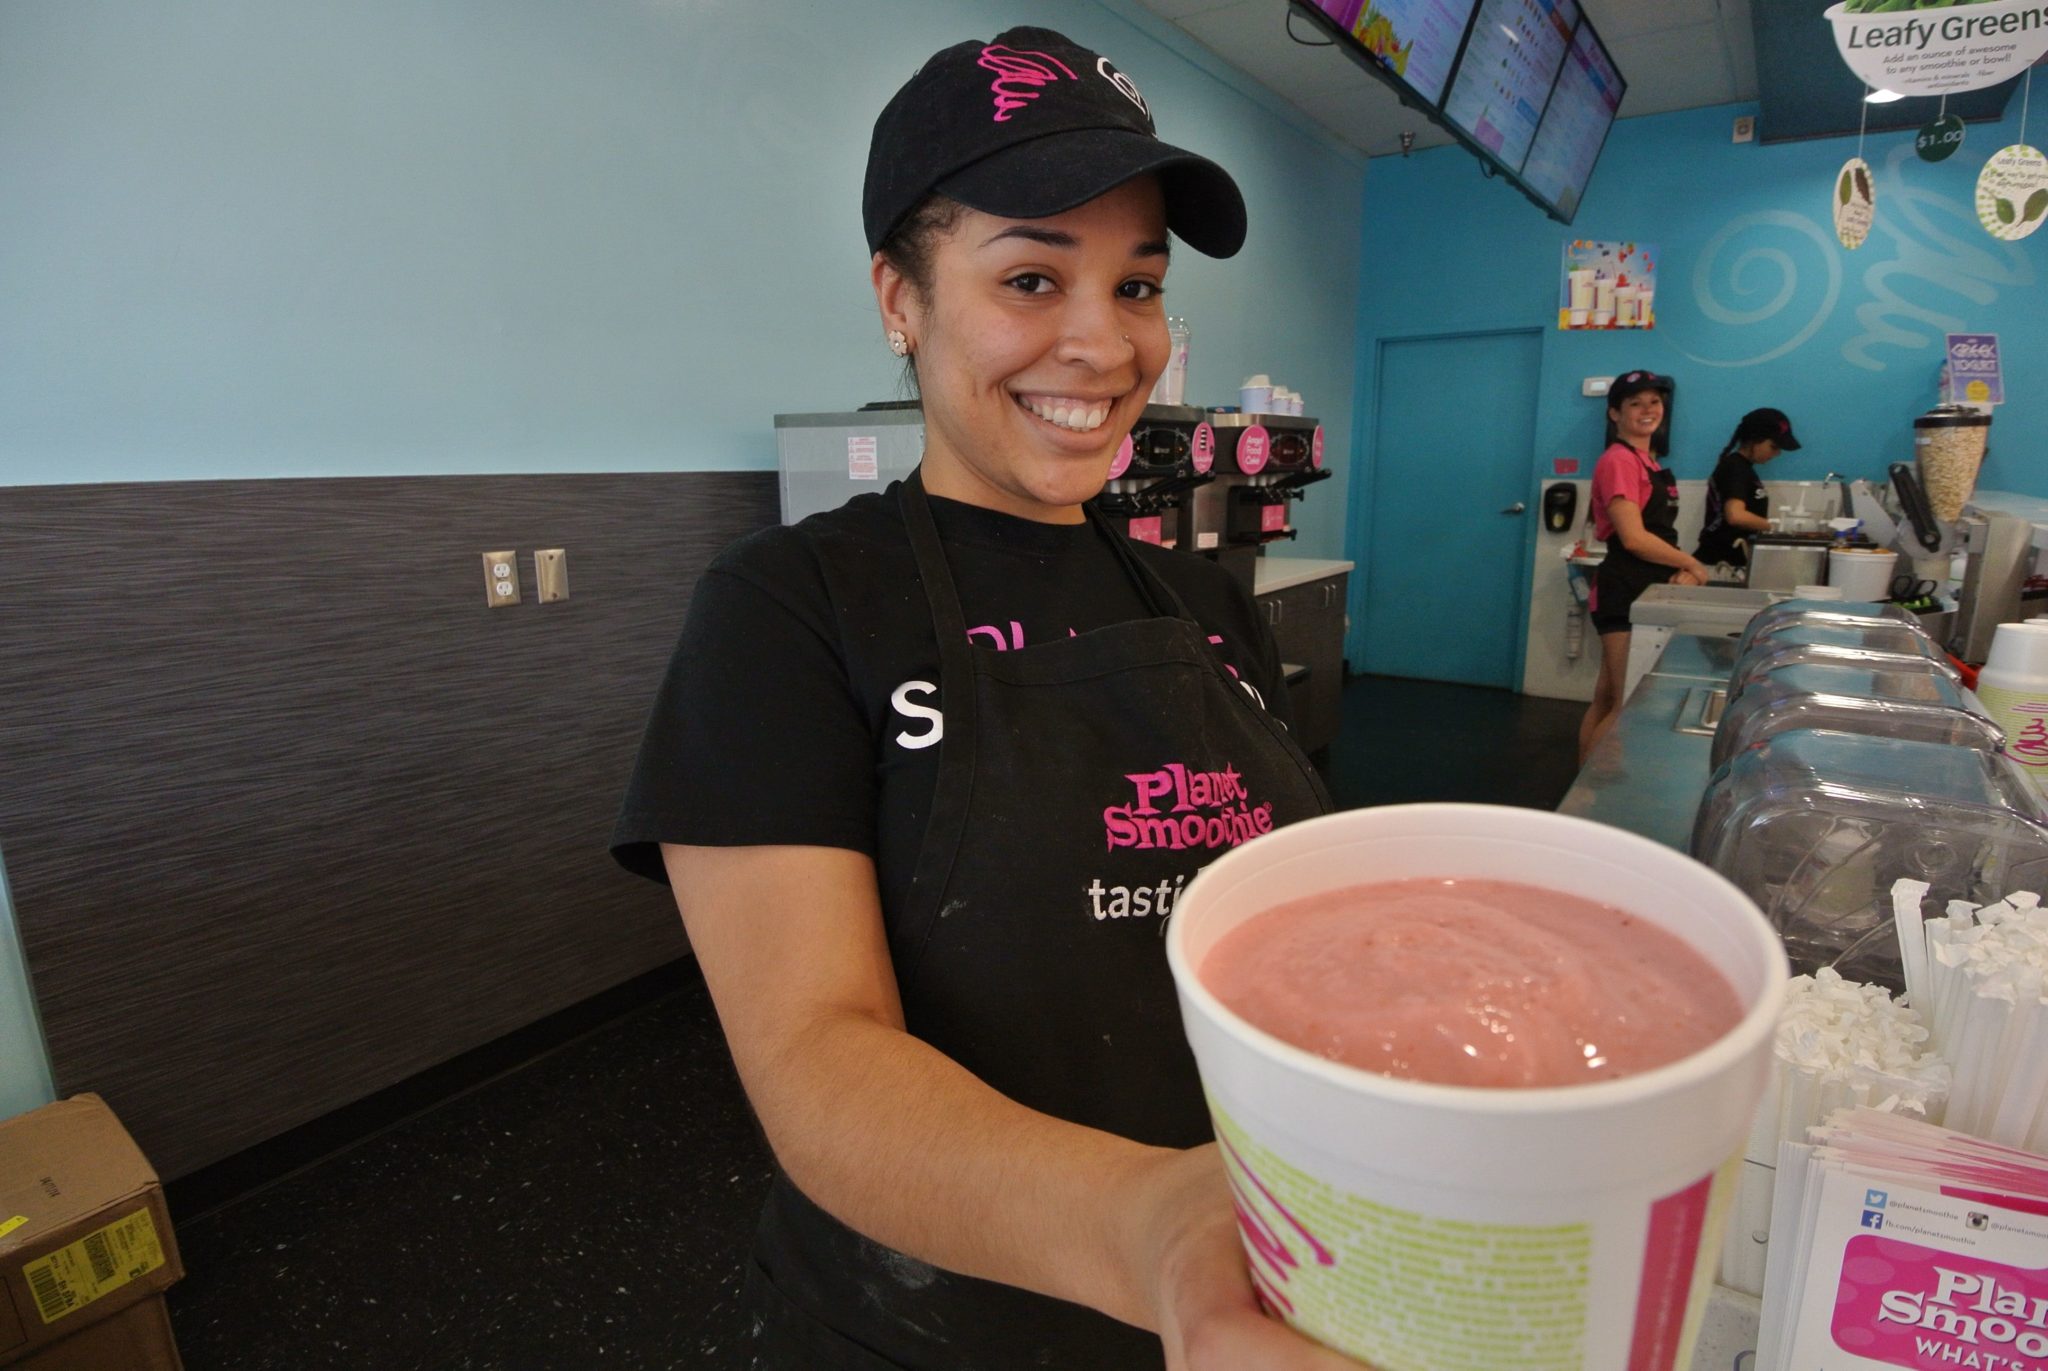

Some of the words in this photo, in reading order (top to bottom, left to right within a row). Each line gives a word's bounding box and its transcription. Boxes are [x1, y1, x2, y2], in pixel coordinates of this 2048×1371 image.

[1848, 18, 1937, 50] Leafy
[1883, 54, 1904, 64] Add
[1921, 50, 1953, 59] ounce
[1955, 46, 1967, 56] of
[1969, 44, 2017, 54] awesome
[1886, 66, 1897, 75] to
[1899, 64, 1918, 74] any
[1920, 59, 1966, 70] smoothie
[1969, 57, 1980, 66] or
[1917, 130, 1964, 149] $1.00
[1124, 761, 1248, 816] Planet
[1103, 801, 1273, 853] Smoothie
[1889, 1200, 1959, 1220] @planetsmoothie
[1885, 1219, 1976, 1246] fb.com/planetsmoothie
